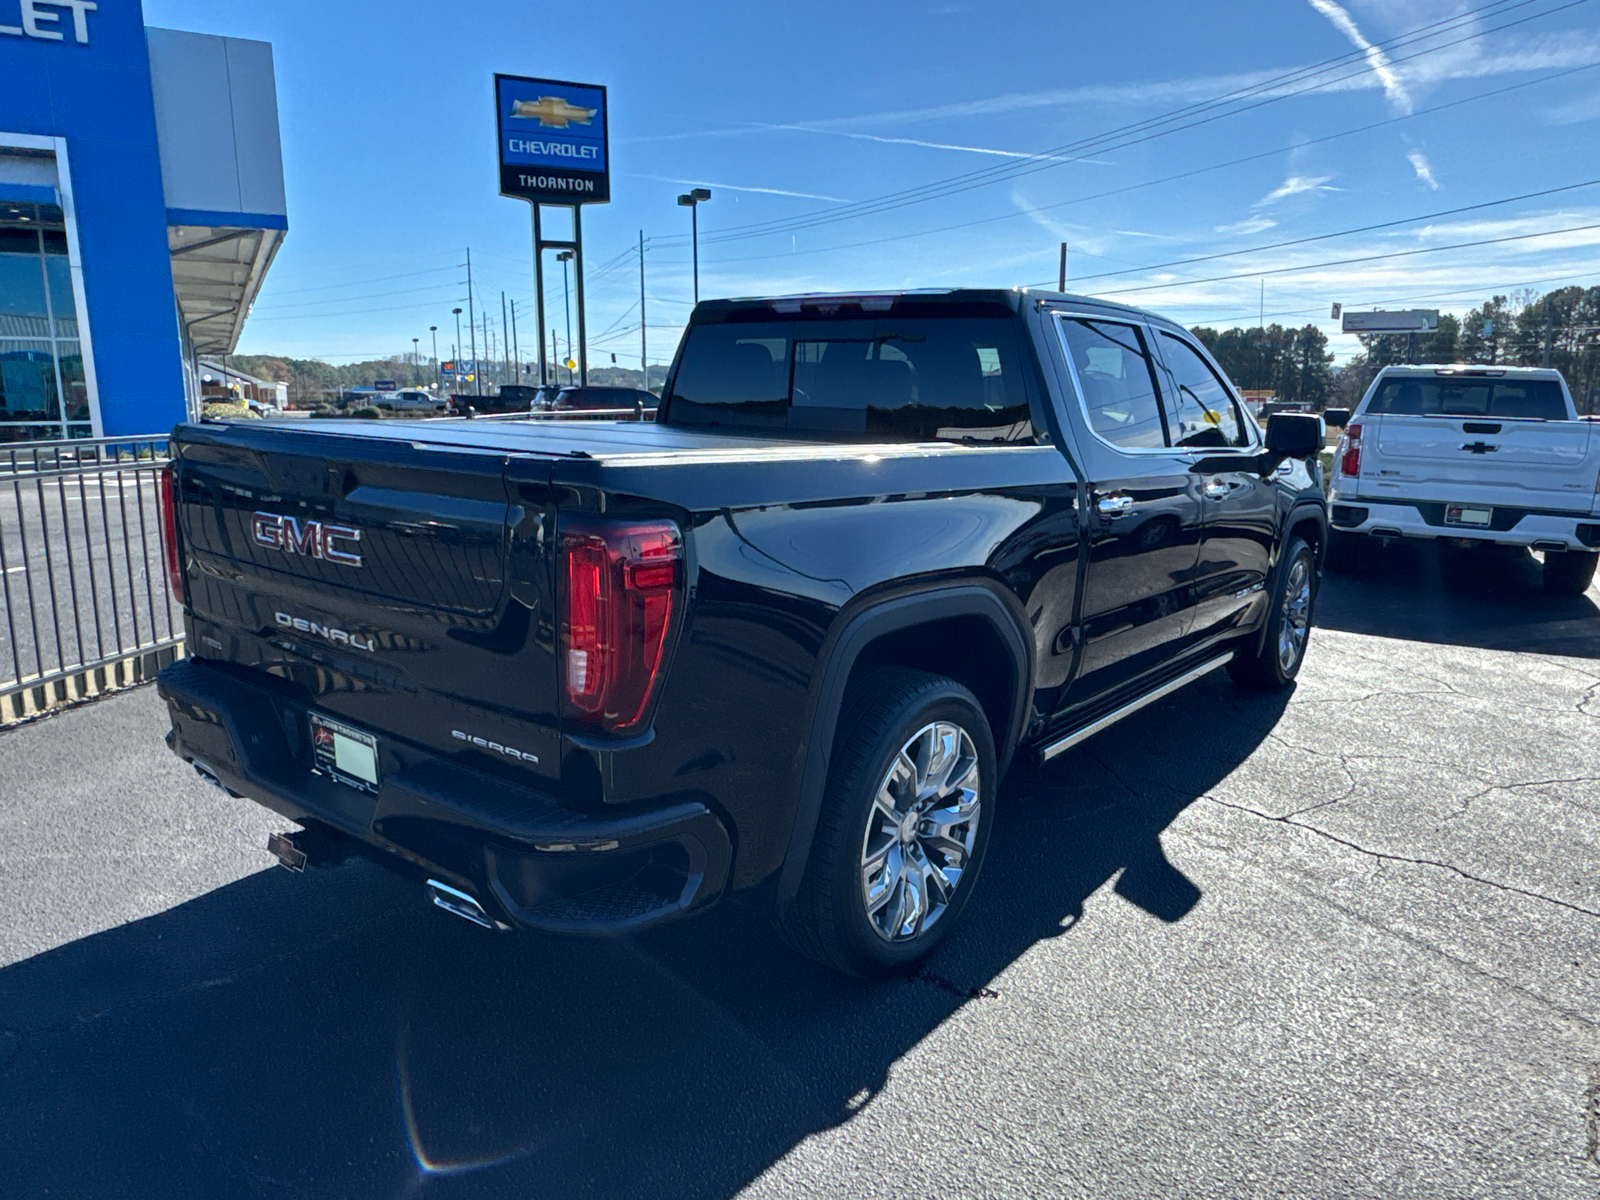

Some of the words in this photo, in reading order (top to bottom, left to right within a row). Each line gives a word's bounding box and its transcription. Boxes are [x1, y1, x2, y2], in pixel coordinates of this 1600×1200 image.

[508, 138, 599, 160] CHEVROLET
[518, 174, 594, 192] THORNTON
[252, 510, 363, 568] GMC
[274, 611, 375, 652] DENALI
[451, 729, 539, 765] SIERRA
